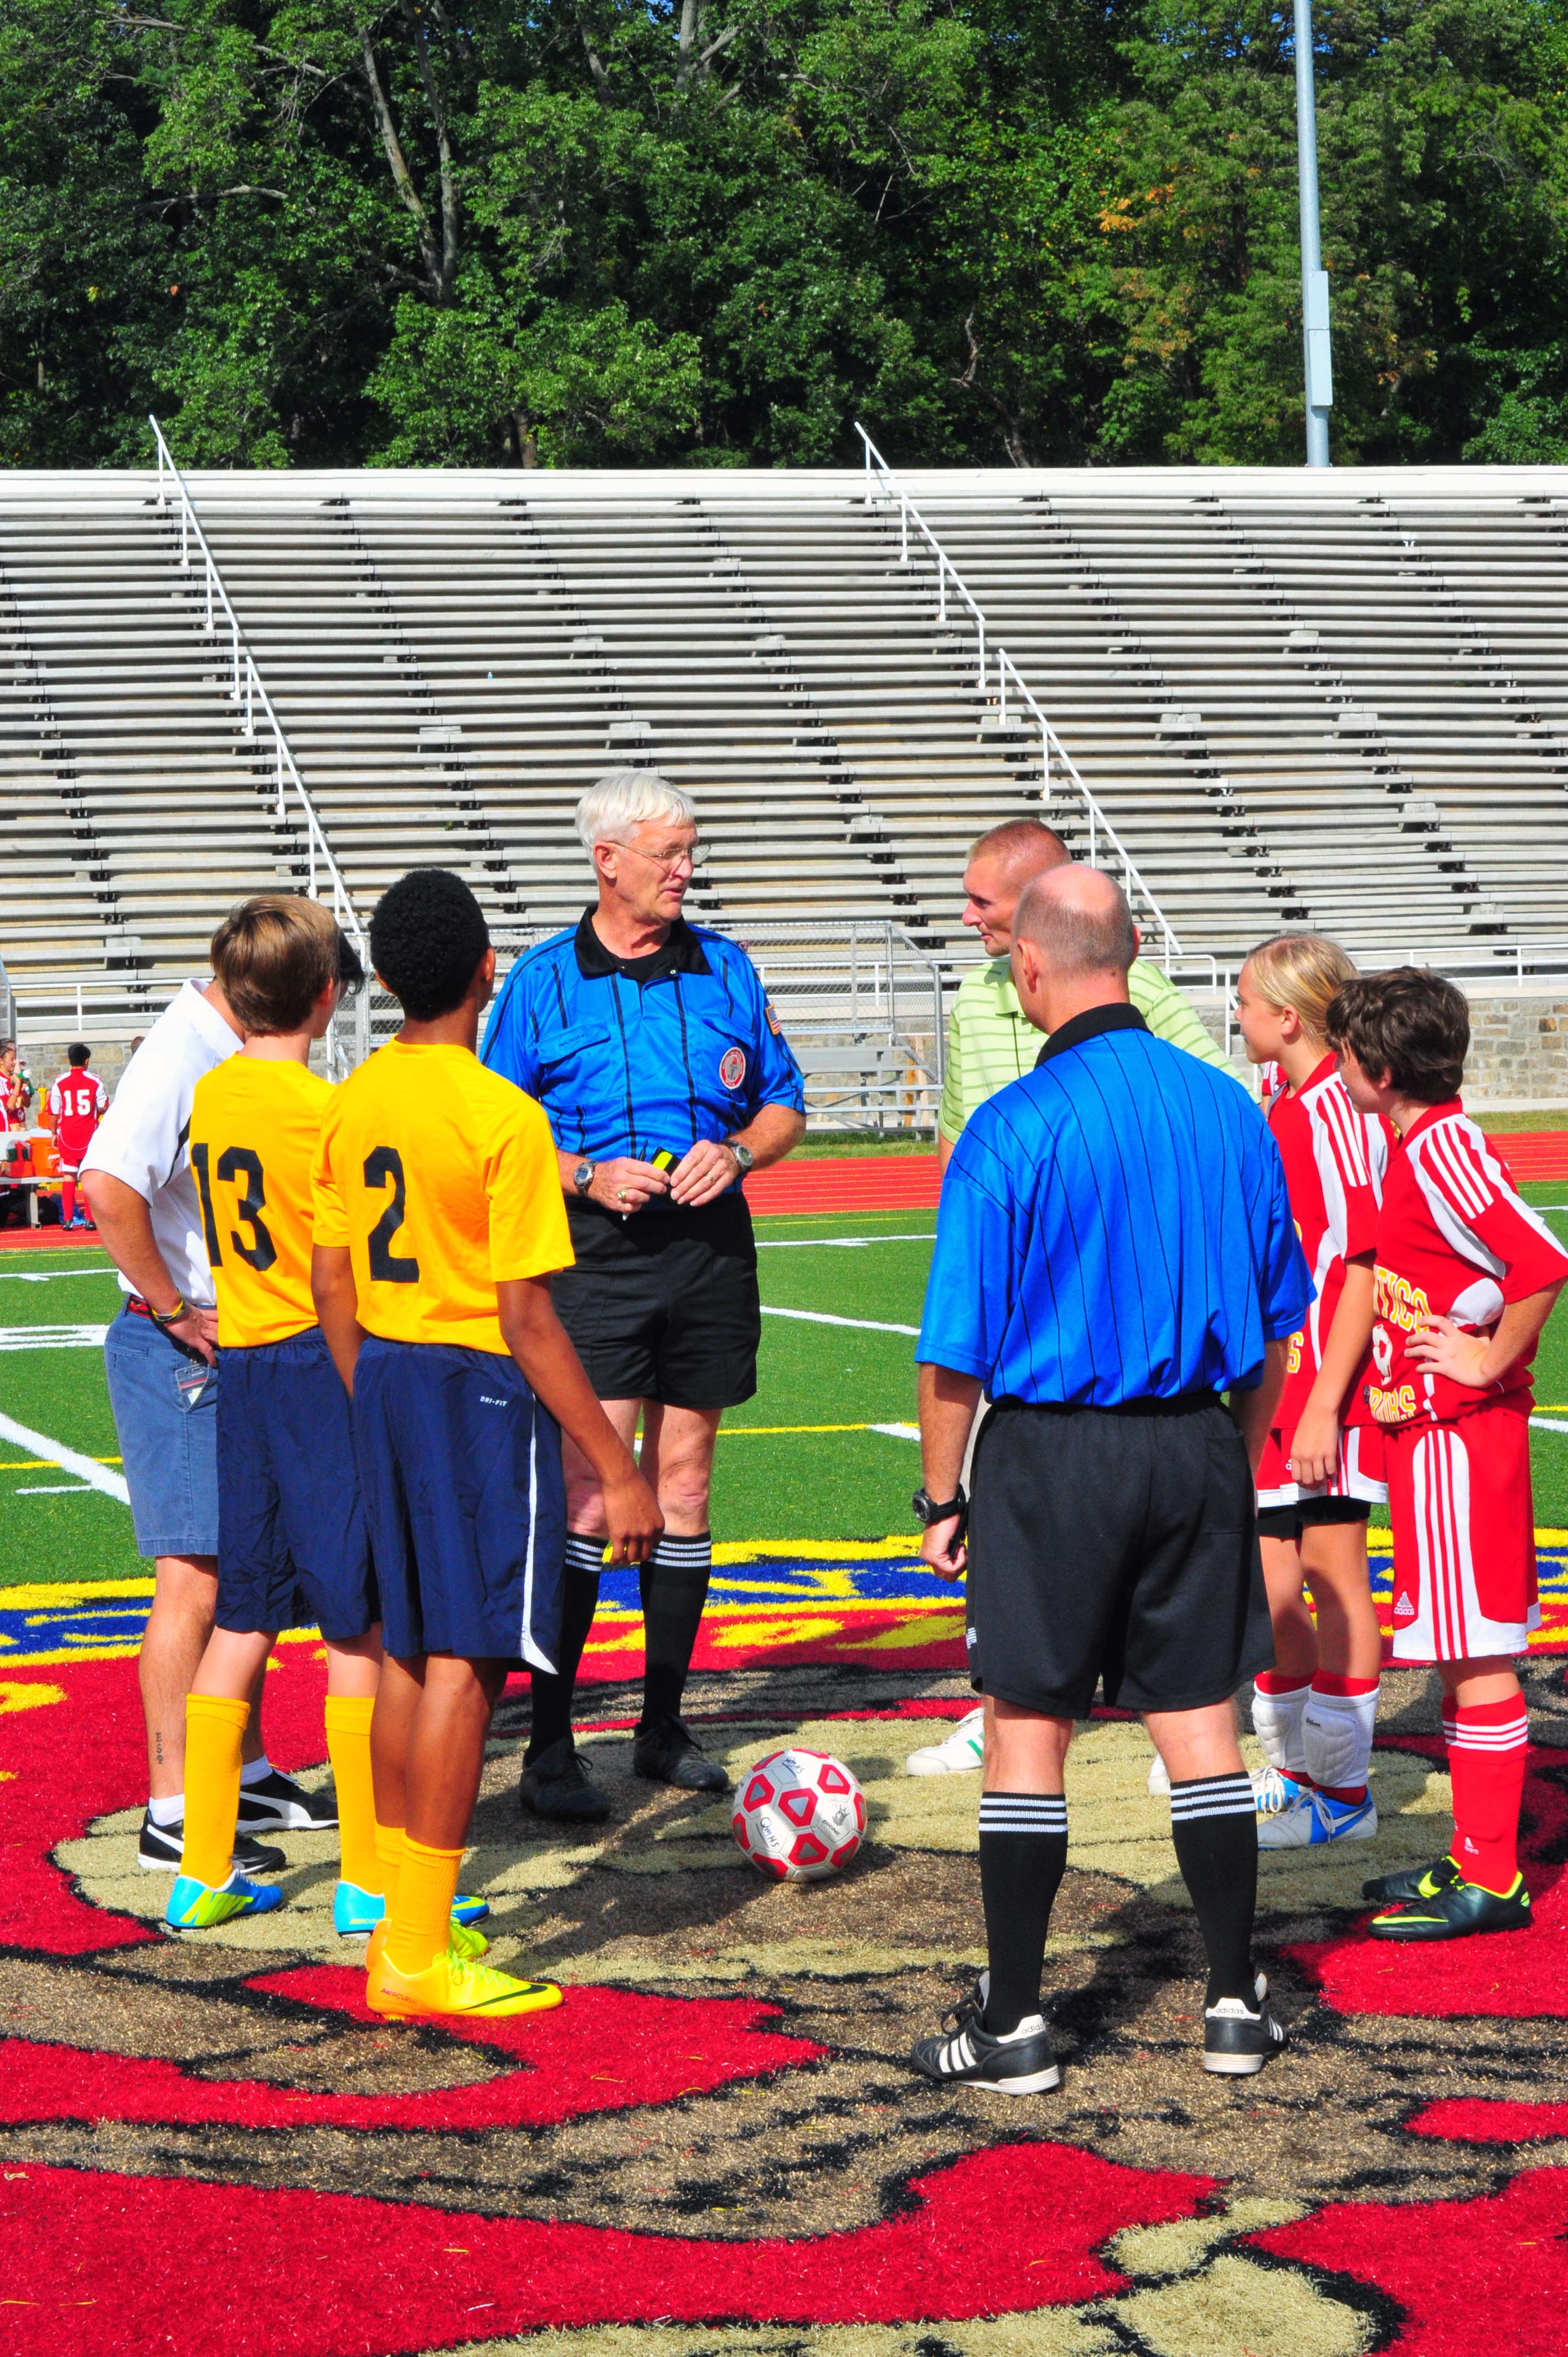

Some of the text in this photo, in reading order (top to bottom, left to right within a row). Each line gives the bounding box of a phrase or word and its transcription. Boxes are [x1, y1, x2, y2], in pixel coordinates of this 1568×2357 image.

[63, 1089, 91, 1116] 15
[191, 1143, 277, 1272] 13
[363, 1146, 420, 1283] 2
[1373, 1264, 1433, 1334] TICO
[479, 1396, 508, 1407] DRI-FIT
